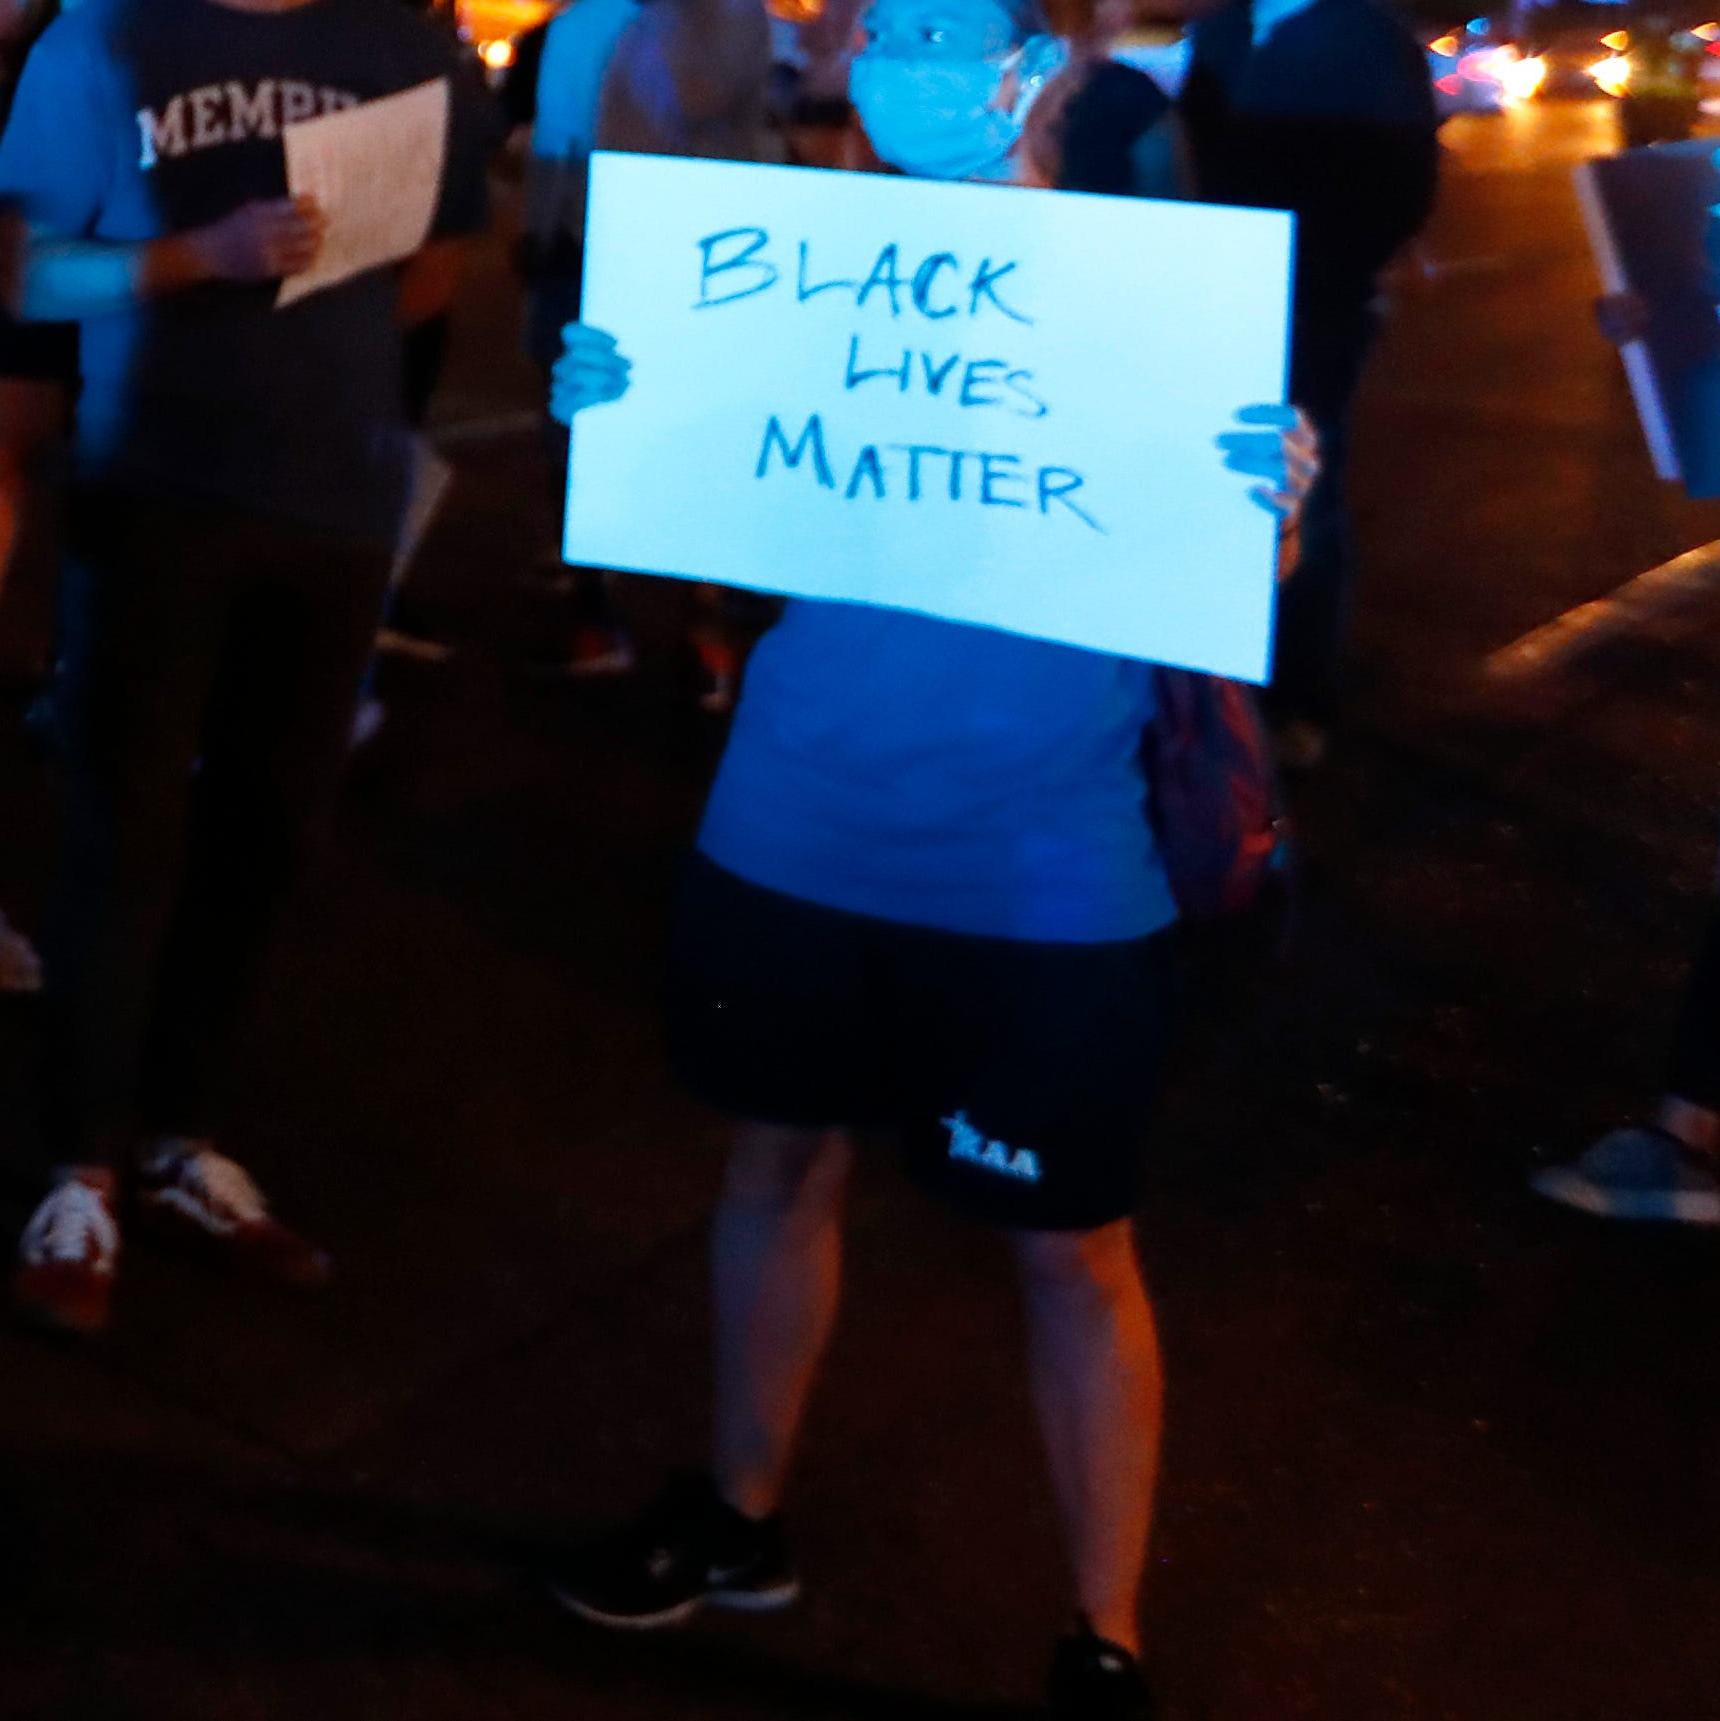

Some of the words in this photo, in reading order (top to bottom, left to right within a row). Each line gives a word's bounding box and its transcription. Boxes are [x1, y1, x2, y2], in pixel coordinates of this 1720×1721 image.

[692, 226, 1036, 326] BLACK
[843, 334, 1048, 419] LIVES
[754, 412, 1111, 536] MATTER
